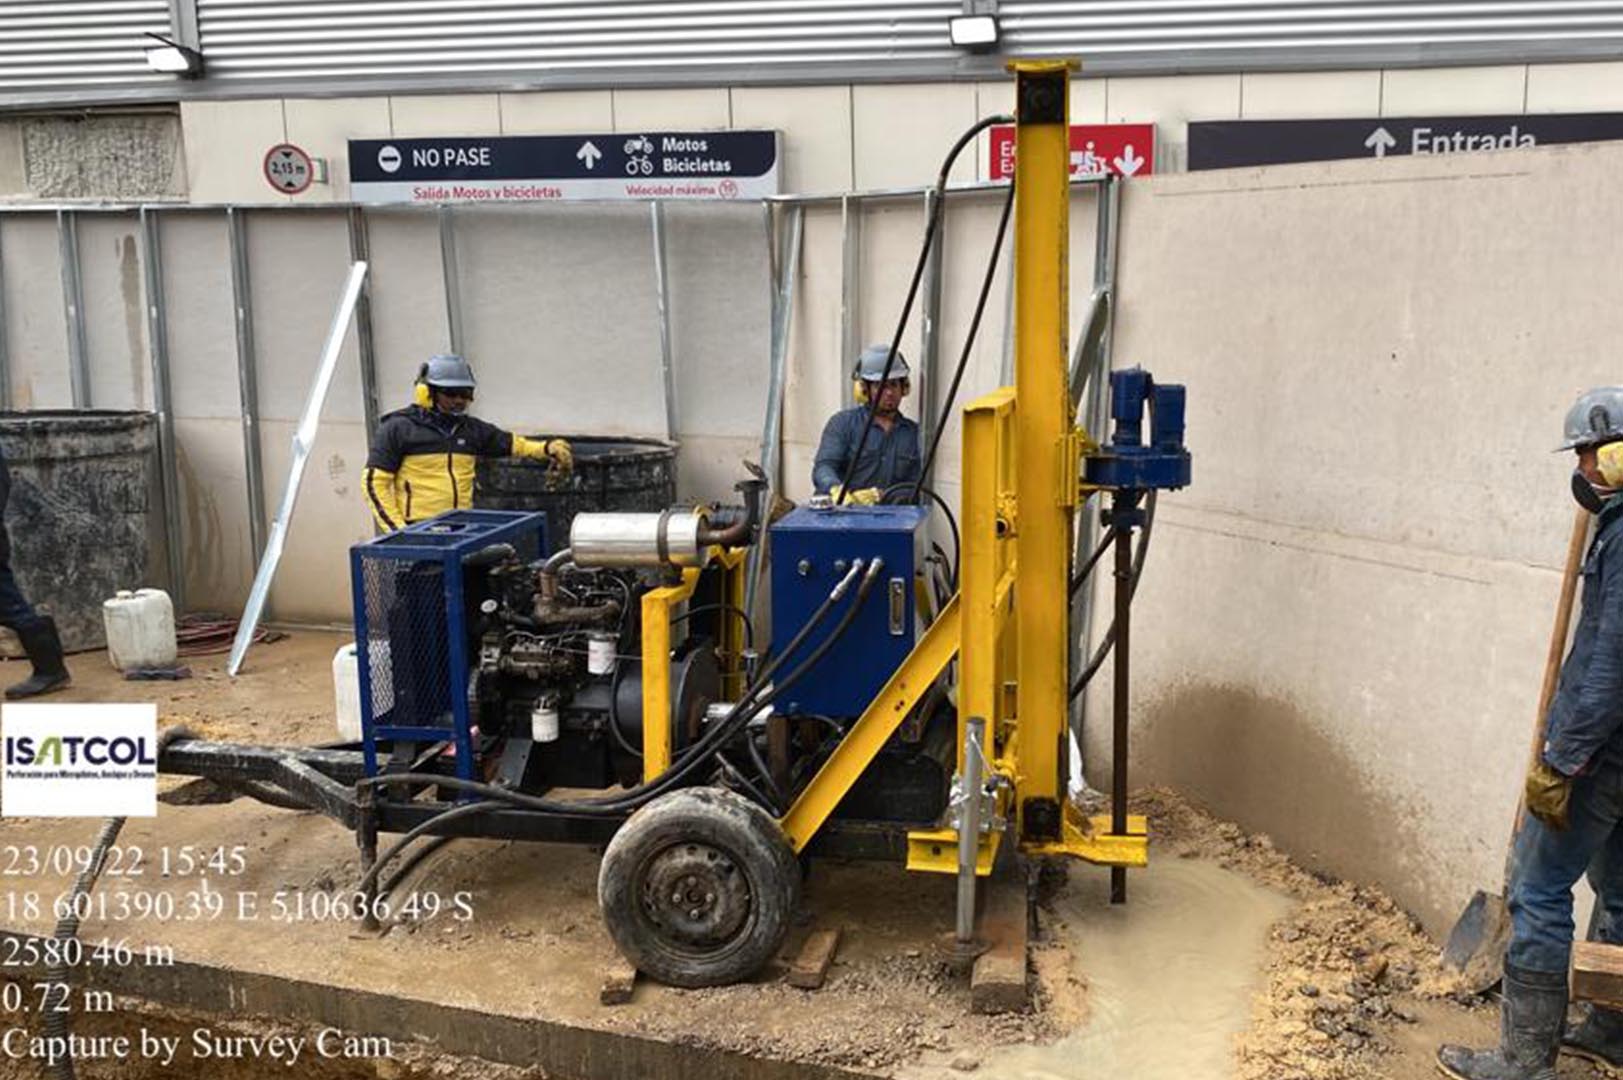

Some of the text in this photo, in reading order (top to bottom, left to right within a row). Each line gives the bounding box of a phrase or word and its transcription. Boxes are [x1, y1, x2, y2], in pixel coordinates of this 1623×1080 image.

[662, 137, 708, 152] Motos
[1411, 125, 1536, 155] Entrada
[412, 148, 491, 167] NO PASE
[662, 157, 732, 173] Bicicletas
[413, 186, 450, 200] Salida
[452, 186, 491, 199] Motos
[503, 185, 562, 198] bicicletas
[625, 184, 673, 196] Velocidad
